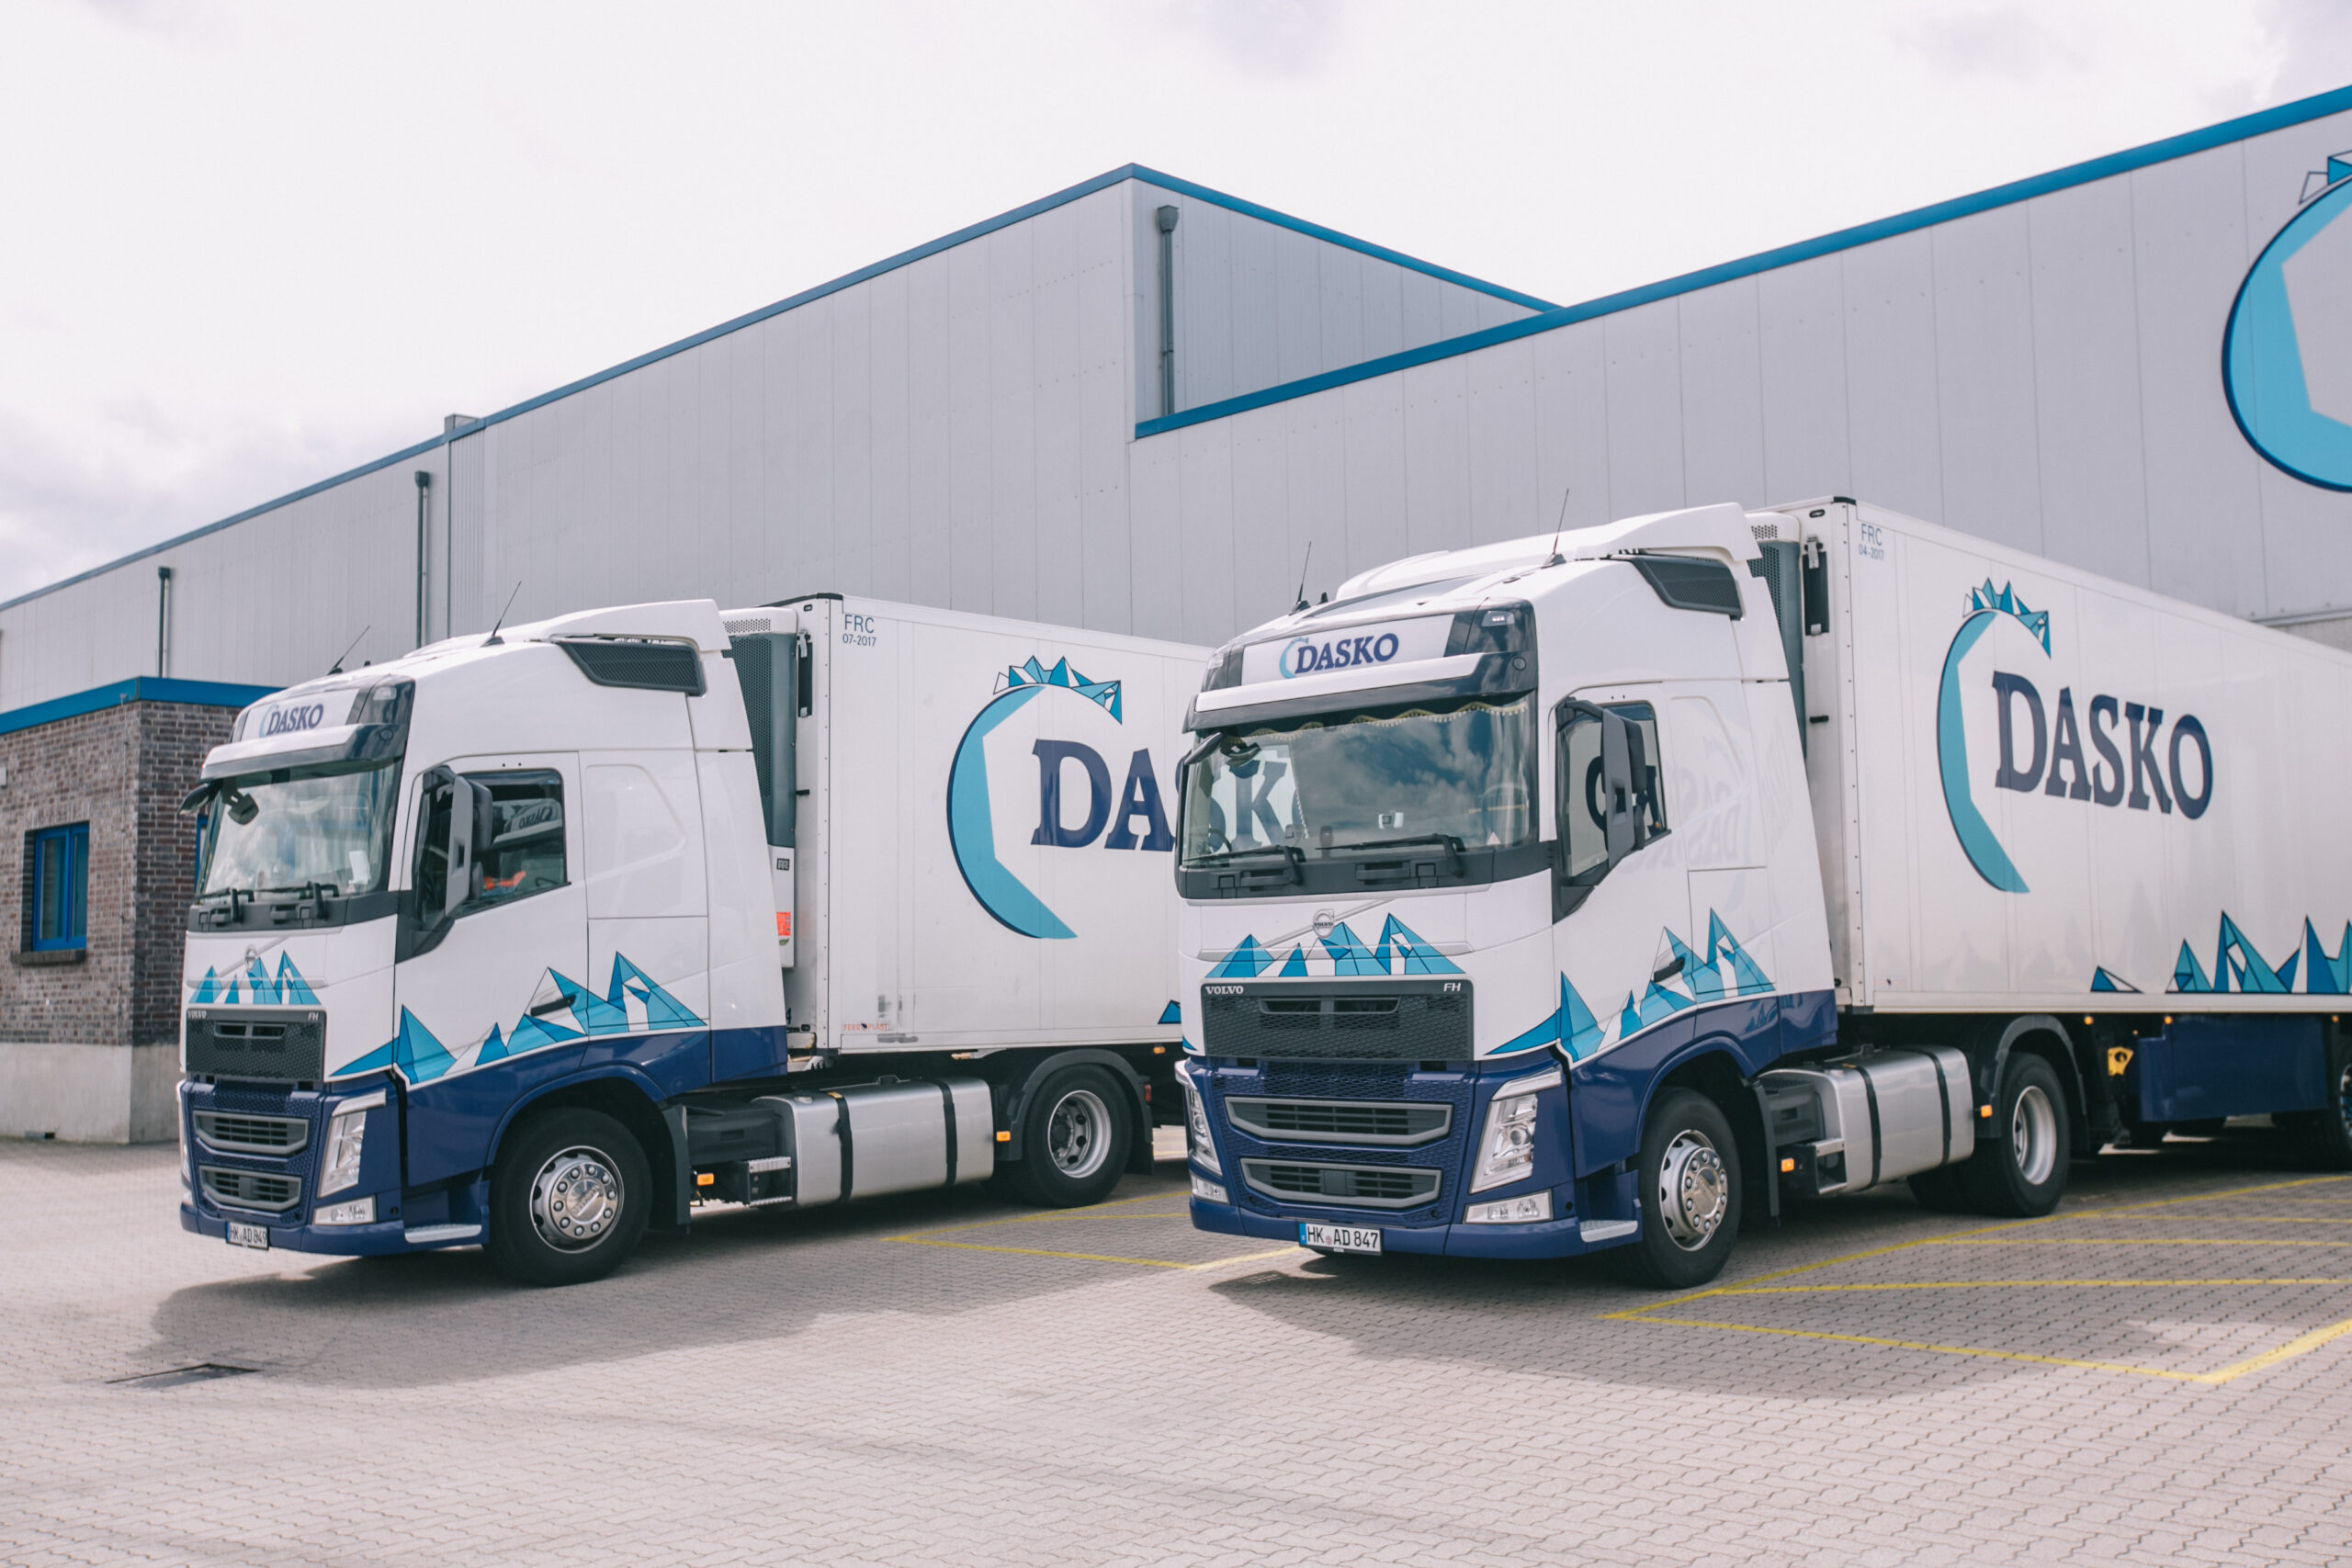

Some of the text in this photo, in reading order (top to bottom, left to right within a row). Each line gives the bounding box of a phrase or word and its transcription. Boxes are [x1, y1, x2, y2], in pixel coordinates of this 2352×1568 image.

[1860, 523, 1883, 547] FRC
[844, 614, 875, 634] FRC
[842, 633, 876, 647] 07-2017
[1294, 632, 1399, 674] DASKO
[266, 704, 324, 736] DASKO
[1991, 670, 2213, 820] DASKO
[1204, 986, 1244, 995] VOLVO
[1443, 982, 1462, 992] FH
[308, 1011, 319, 1021] FH
[1306, 1225, 1379, 1248] HK AD 847
